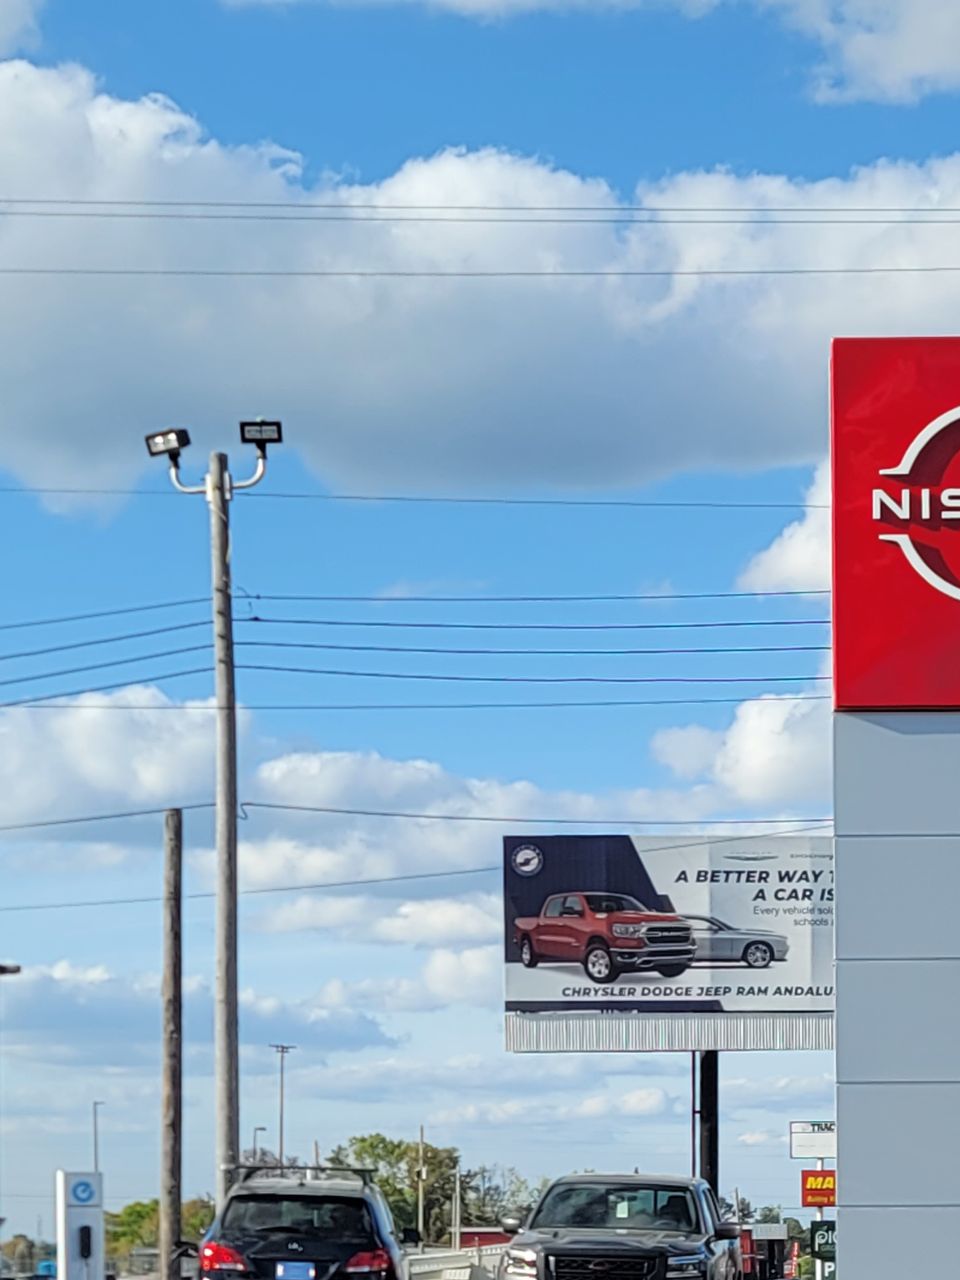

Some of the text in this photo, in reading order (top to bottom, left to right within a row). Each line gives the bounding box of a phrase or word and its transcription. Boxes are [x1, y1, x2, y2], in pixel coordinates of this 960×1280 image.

[674, 870, 689, 883] A
[695, 870, 771, 883] BETTER
[777, 870, 824, 883] WAY
[752, 888, 767, 901] A
[774, 888, 814, 901] CAR
[753, 906, 780, 916] Every
[793, 918, 828, 926] schools
[561, 986, 834, 997] CHRYSLER DODGE JEEP RAM ANDALU
